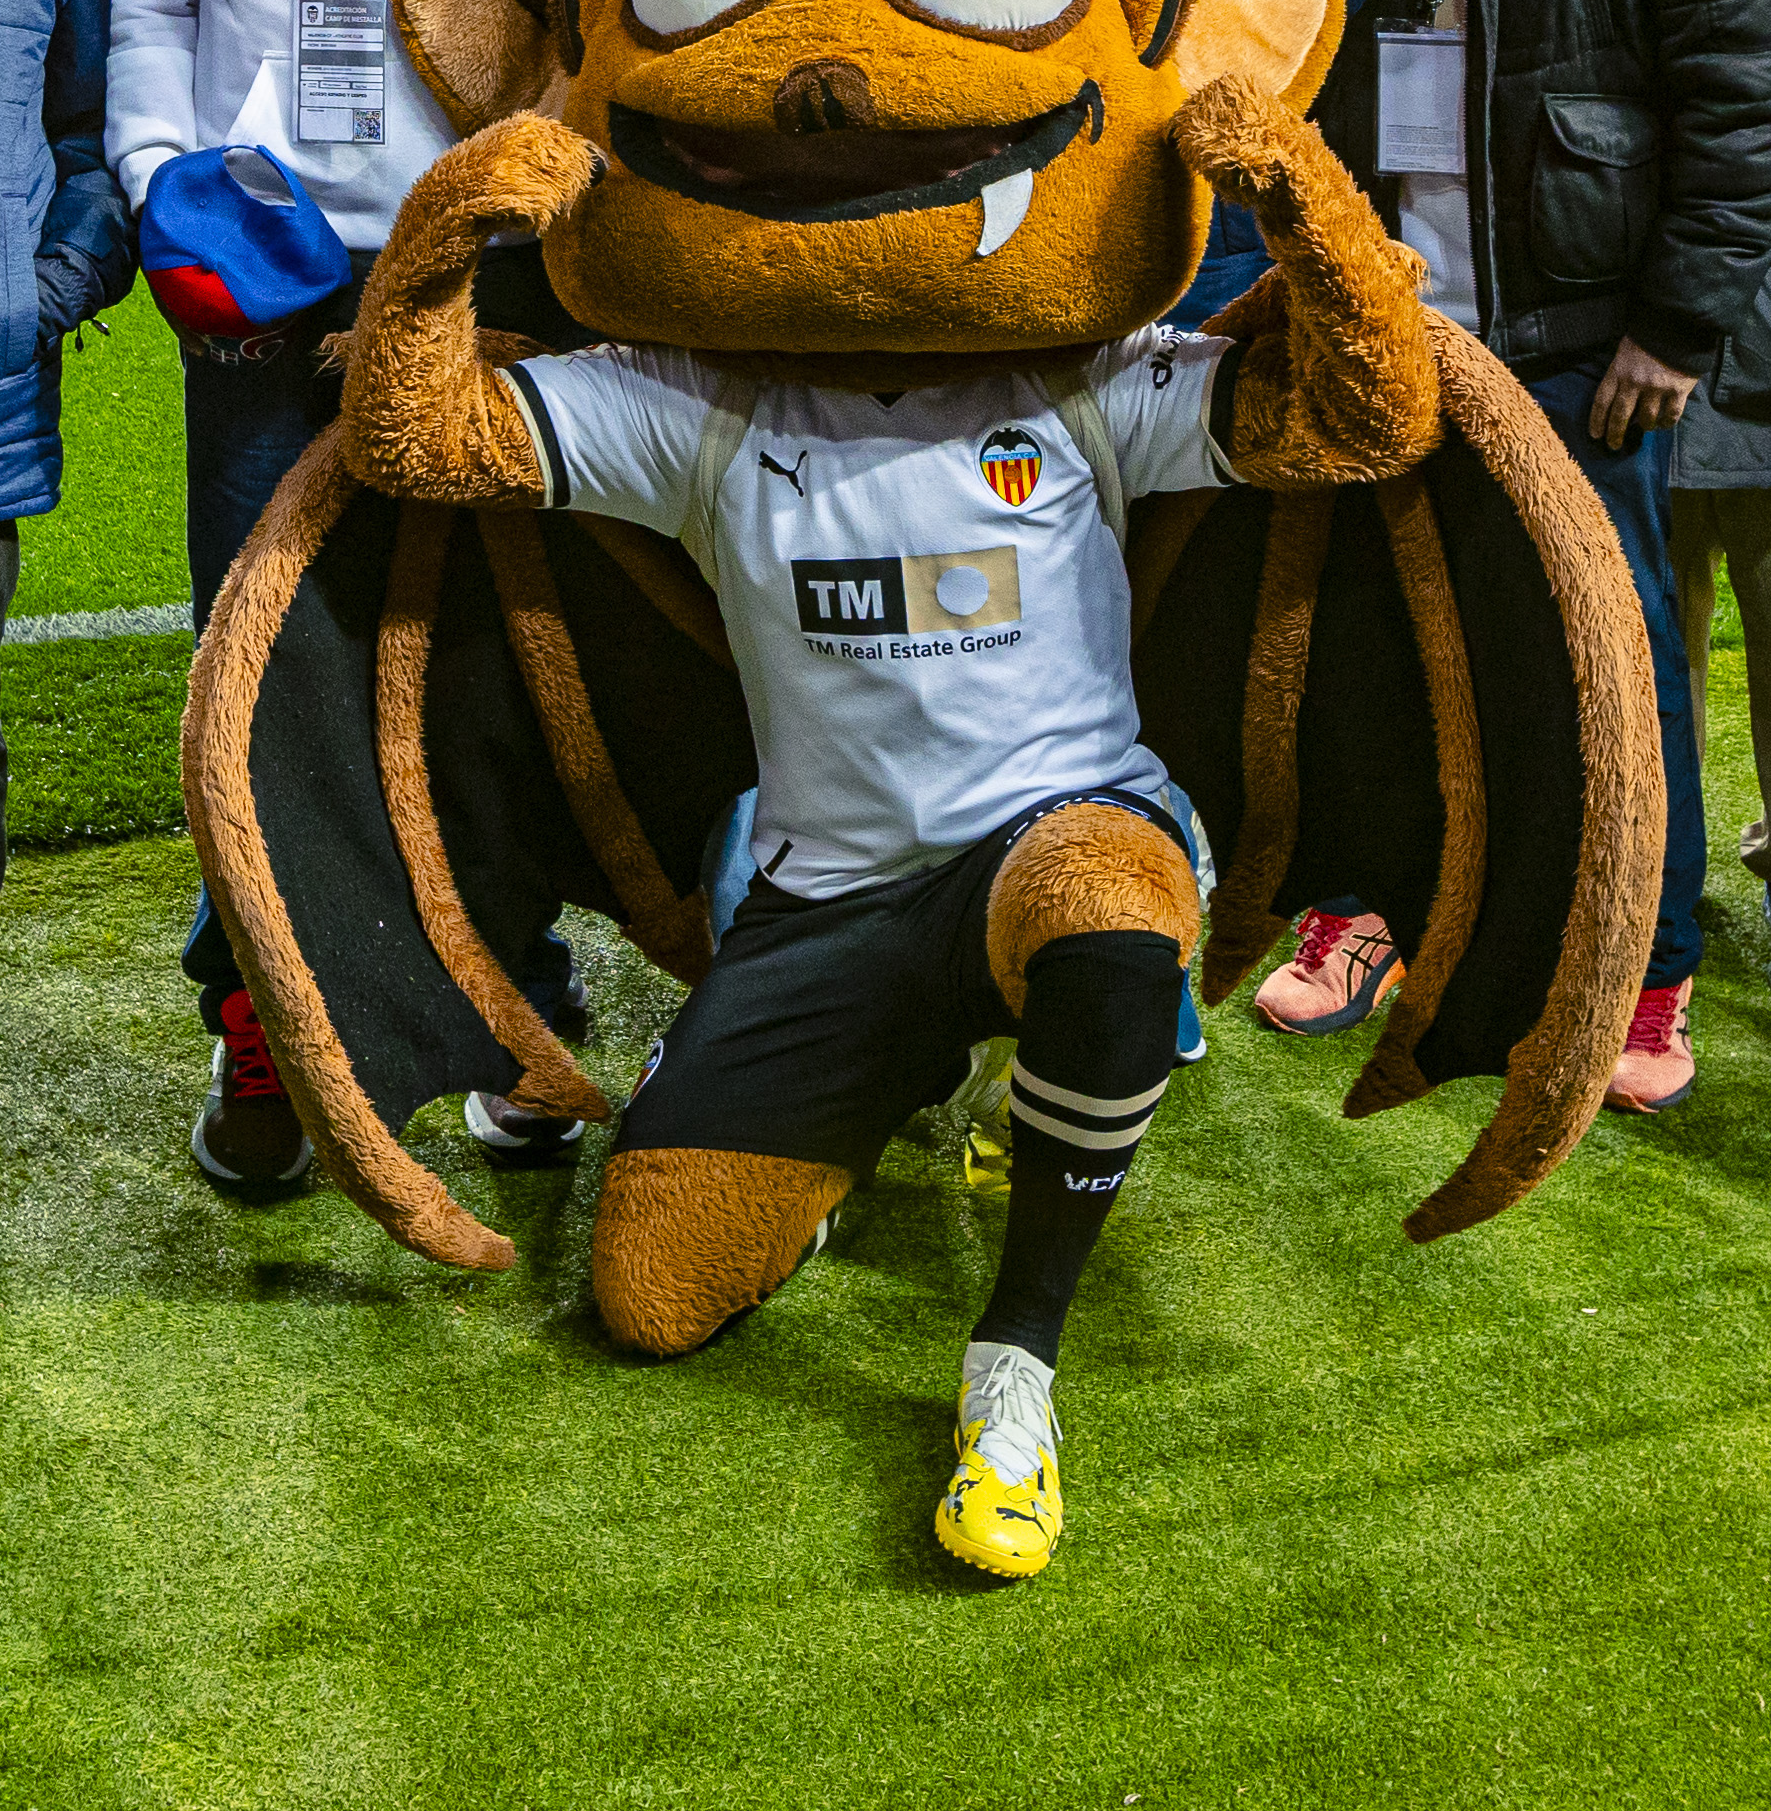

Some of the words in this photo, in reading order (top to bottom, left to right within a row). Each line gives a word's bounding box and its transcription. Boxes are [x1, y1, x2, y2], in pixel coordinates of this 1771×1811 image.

[984, 452, 1022, 462] VALENCIA
[808, 580, 885, 620] TM
[804, 639, 835, 657] TM
[840, 642, 882, 660] Real
[890, 640, 953, 659] Estate
[960, 630, 1021, 653] Group
